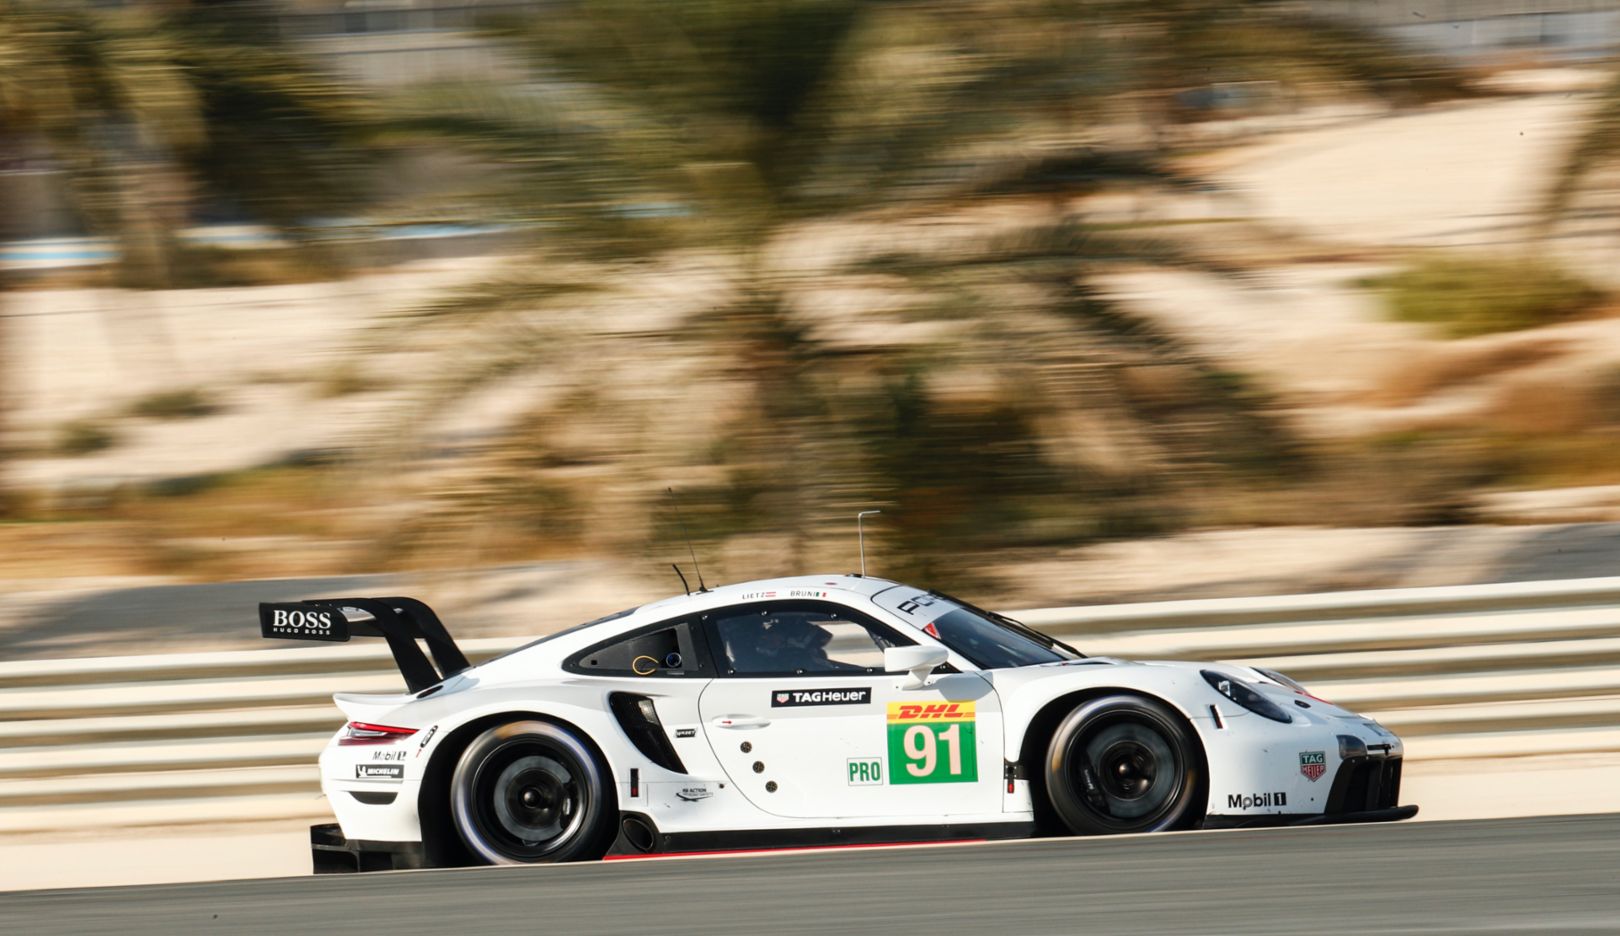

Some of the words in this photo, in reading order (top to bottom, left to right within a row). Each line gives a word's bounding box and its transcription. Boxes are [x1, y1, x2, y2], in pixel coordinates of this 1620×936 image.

[742, 592, 765, 600] LIETZ
[273, 610, 331, 629] BOSS
[898, 704, 963, 719] DHL
[904, 724, 962, 777] 91
[1303, 755, 1323, 763] TAG
[849, 762, 880, 782] PRO
[1302, 765, 1324, 779] HEUER
[1228, 793, 1271, 809] Mobil
[1274, 792, 1287, 806] 1
